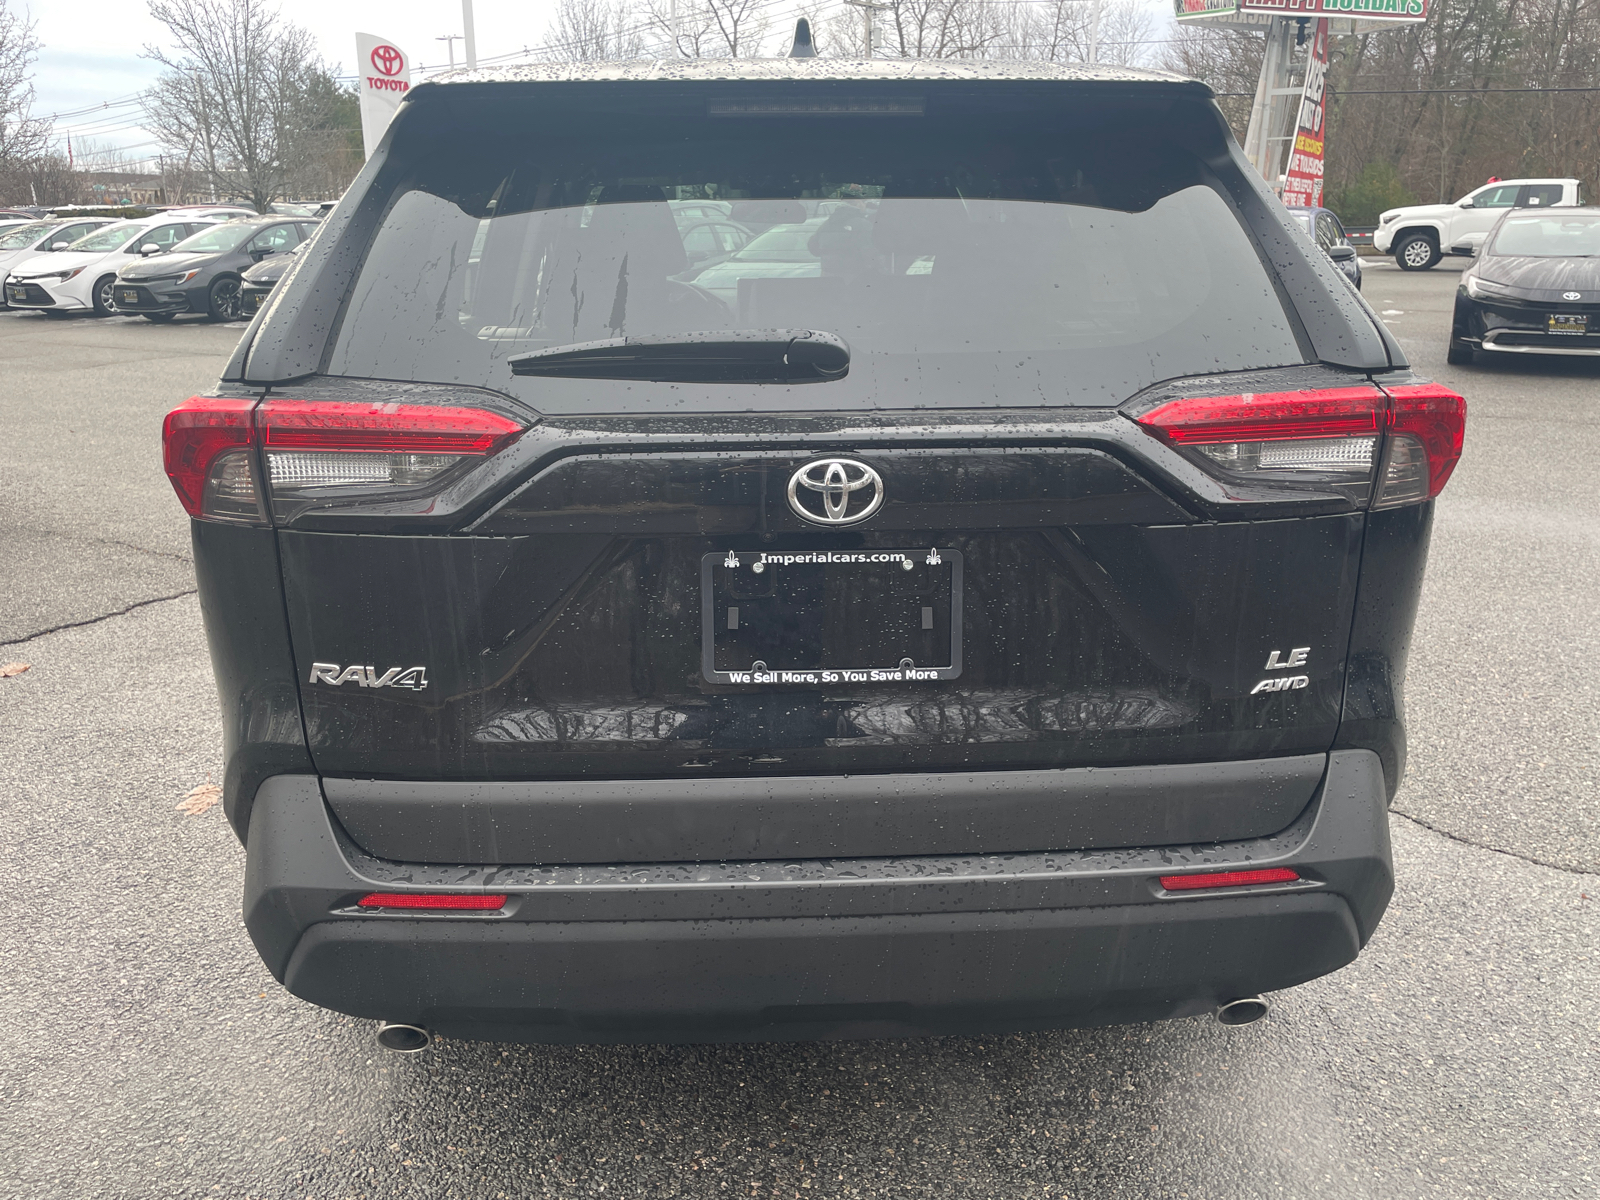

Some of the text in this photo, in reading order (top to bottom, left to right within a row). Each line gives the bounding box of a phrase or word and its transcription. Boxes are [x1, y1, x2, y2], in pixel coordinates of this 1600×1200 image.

[366, 76, 410, 93] TOYOTA
[760, 552, 906, 565] Imperialcars.com
[1264, 646, 1311, 671] LE
[309, 662, 428, 691] RAV4
[729, 669, 939, 685] We Sell More, So You Save More
[1249, 675, 1310, 695] AWD
